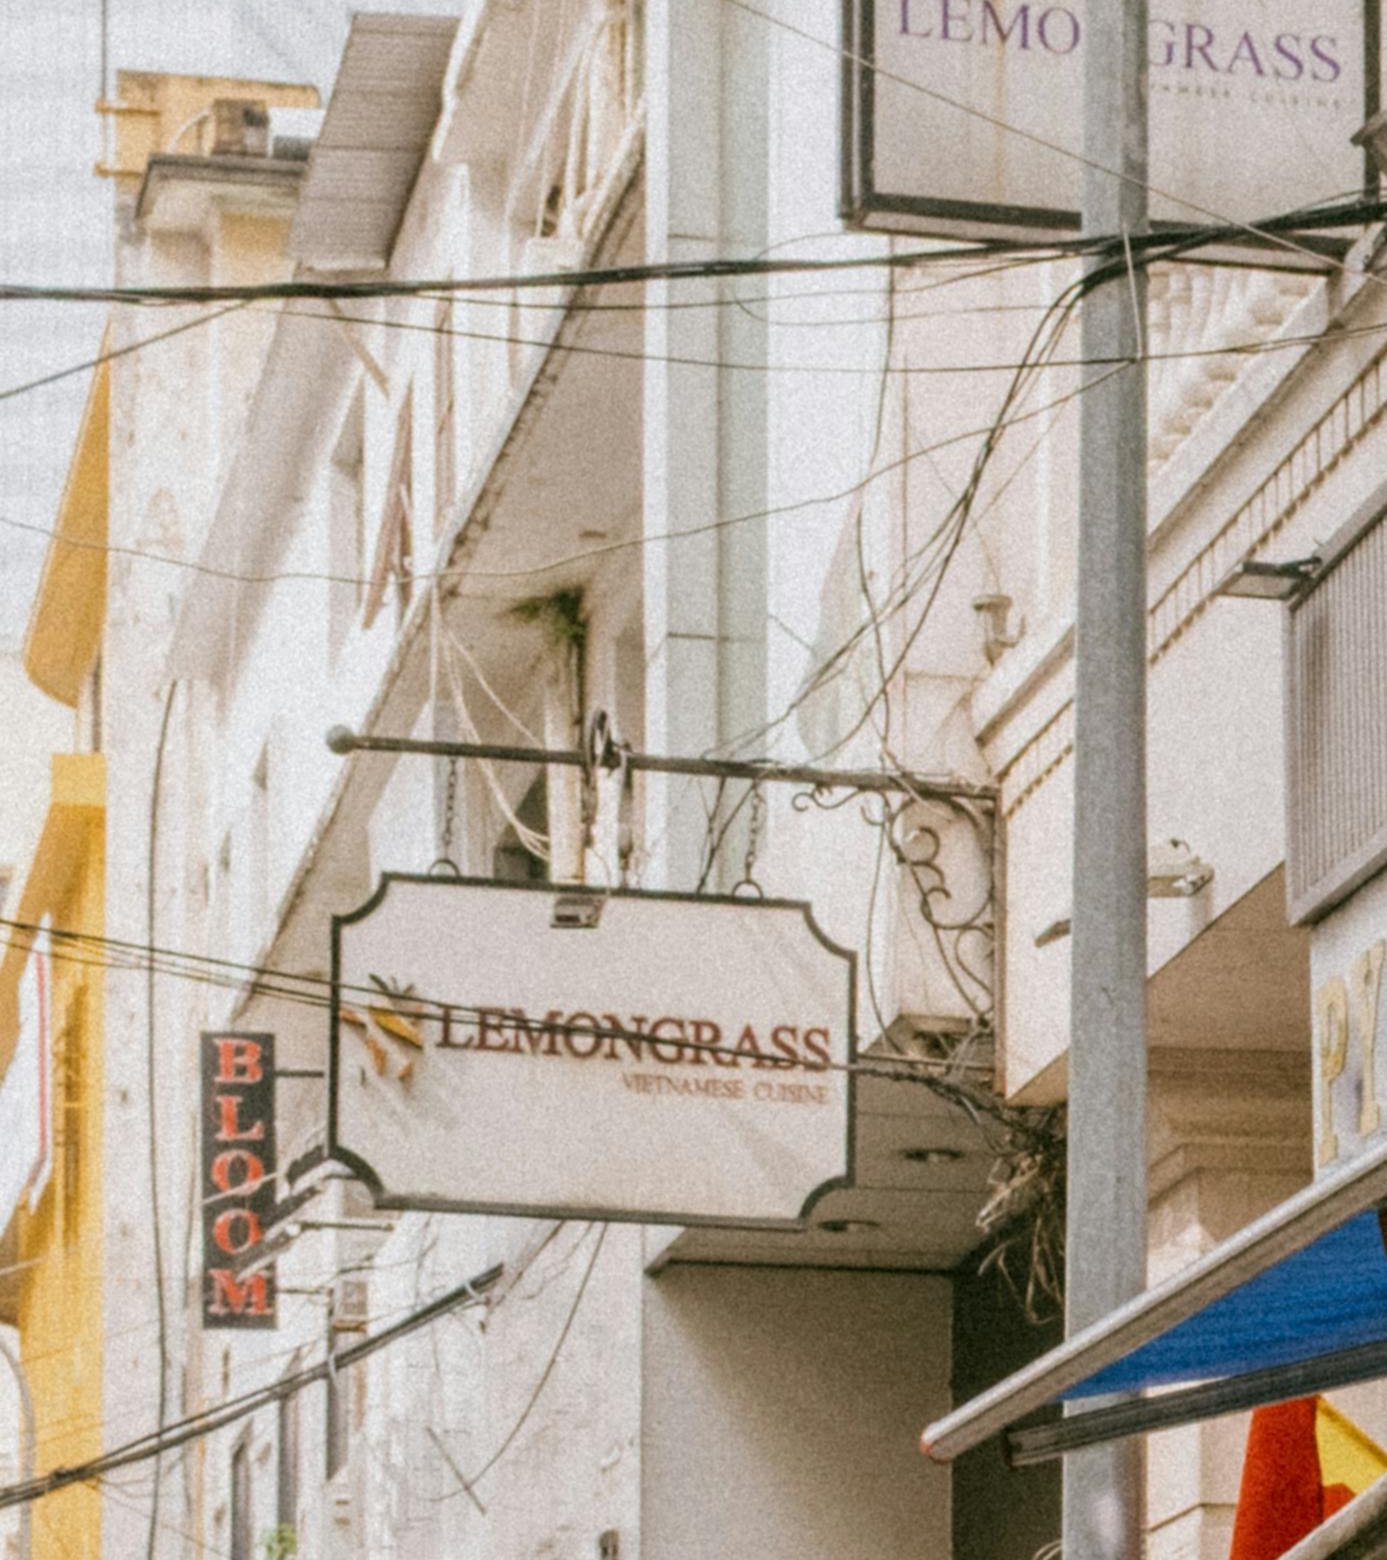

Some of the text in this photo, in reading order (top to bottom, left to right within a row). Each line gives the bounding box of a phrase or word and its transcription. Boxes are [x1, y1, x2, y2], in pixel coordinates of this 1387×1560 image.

[435, 1005, 833, 1073] LEMONGRASS
[622, 1072, 828, 1104] VIETNAMESE CUISINE
[1314, 940, 1385, 1168] PY
[210, 1039, 274, 1318] BLOOM
